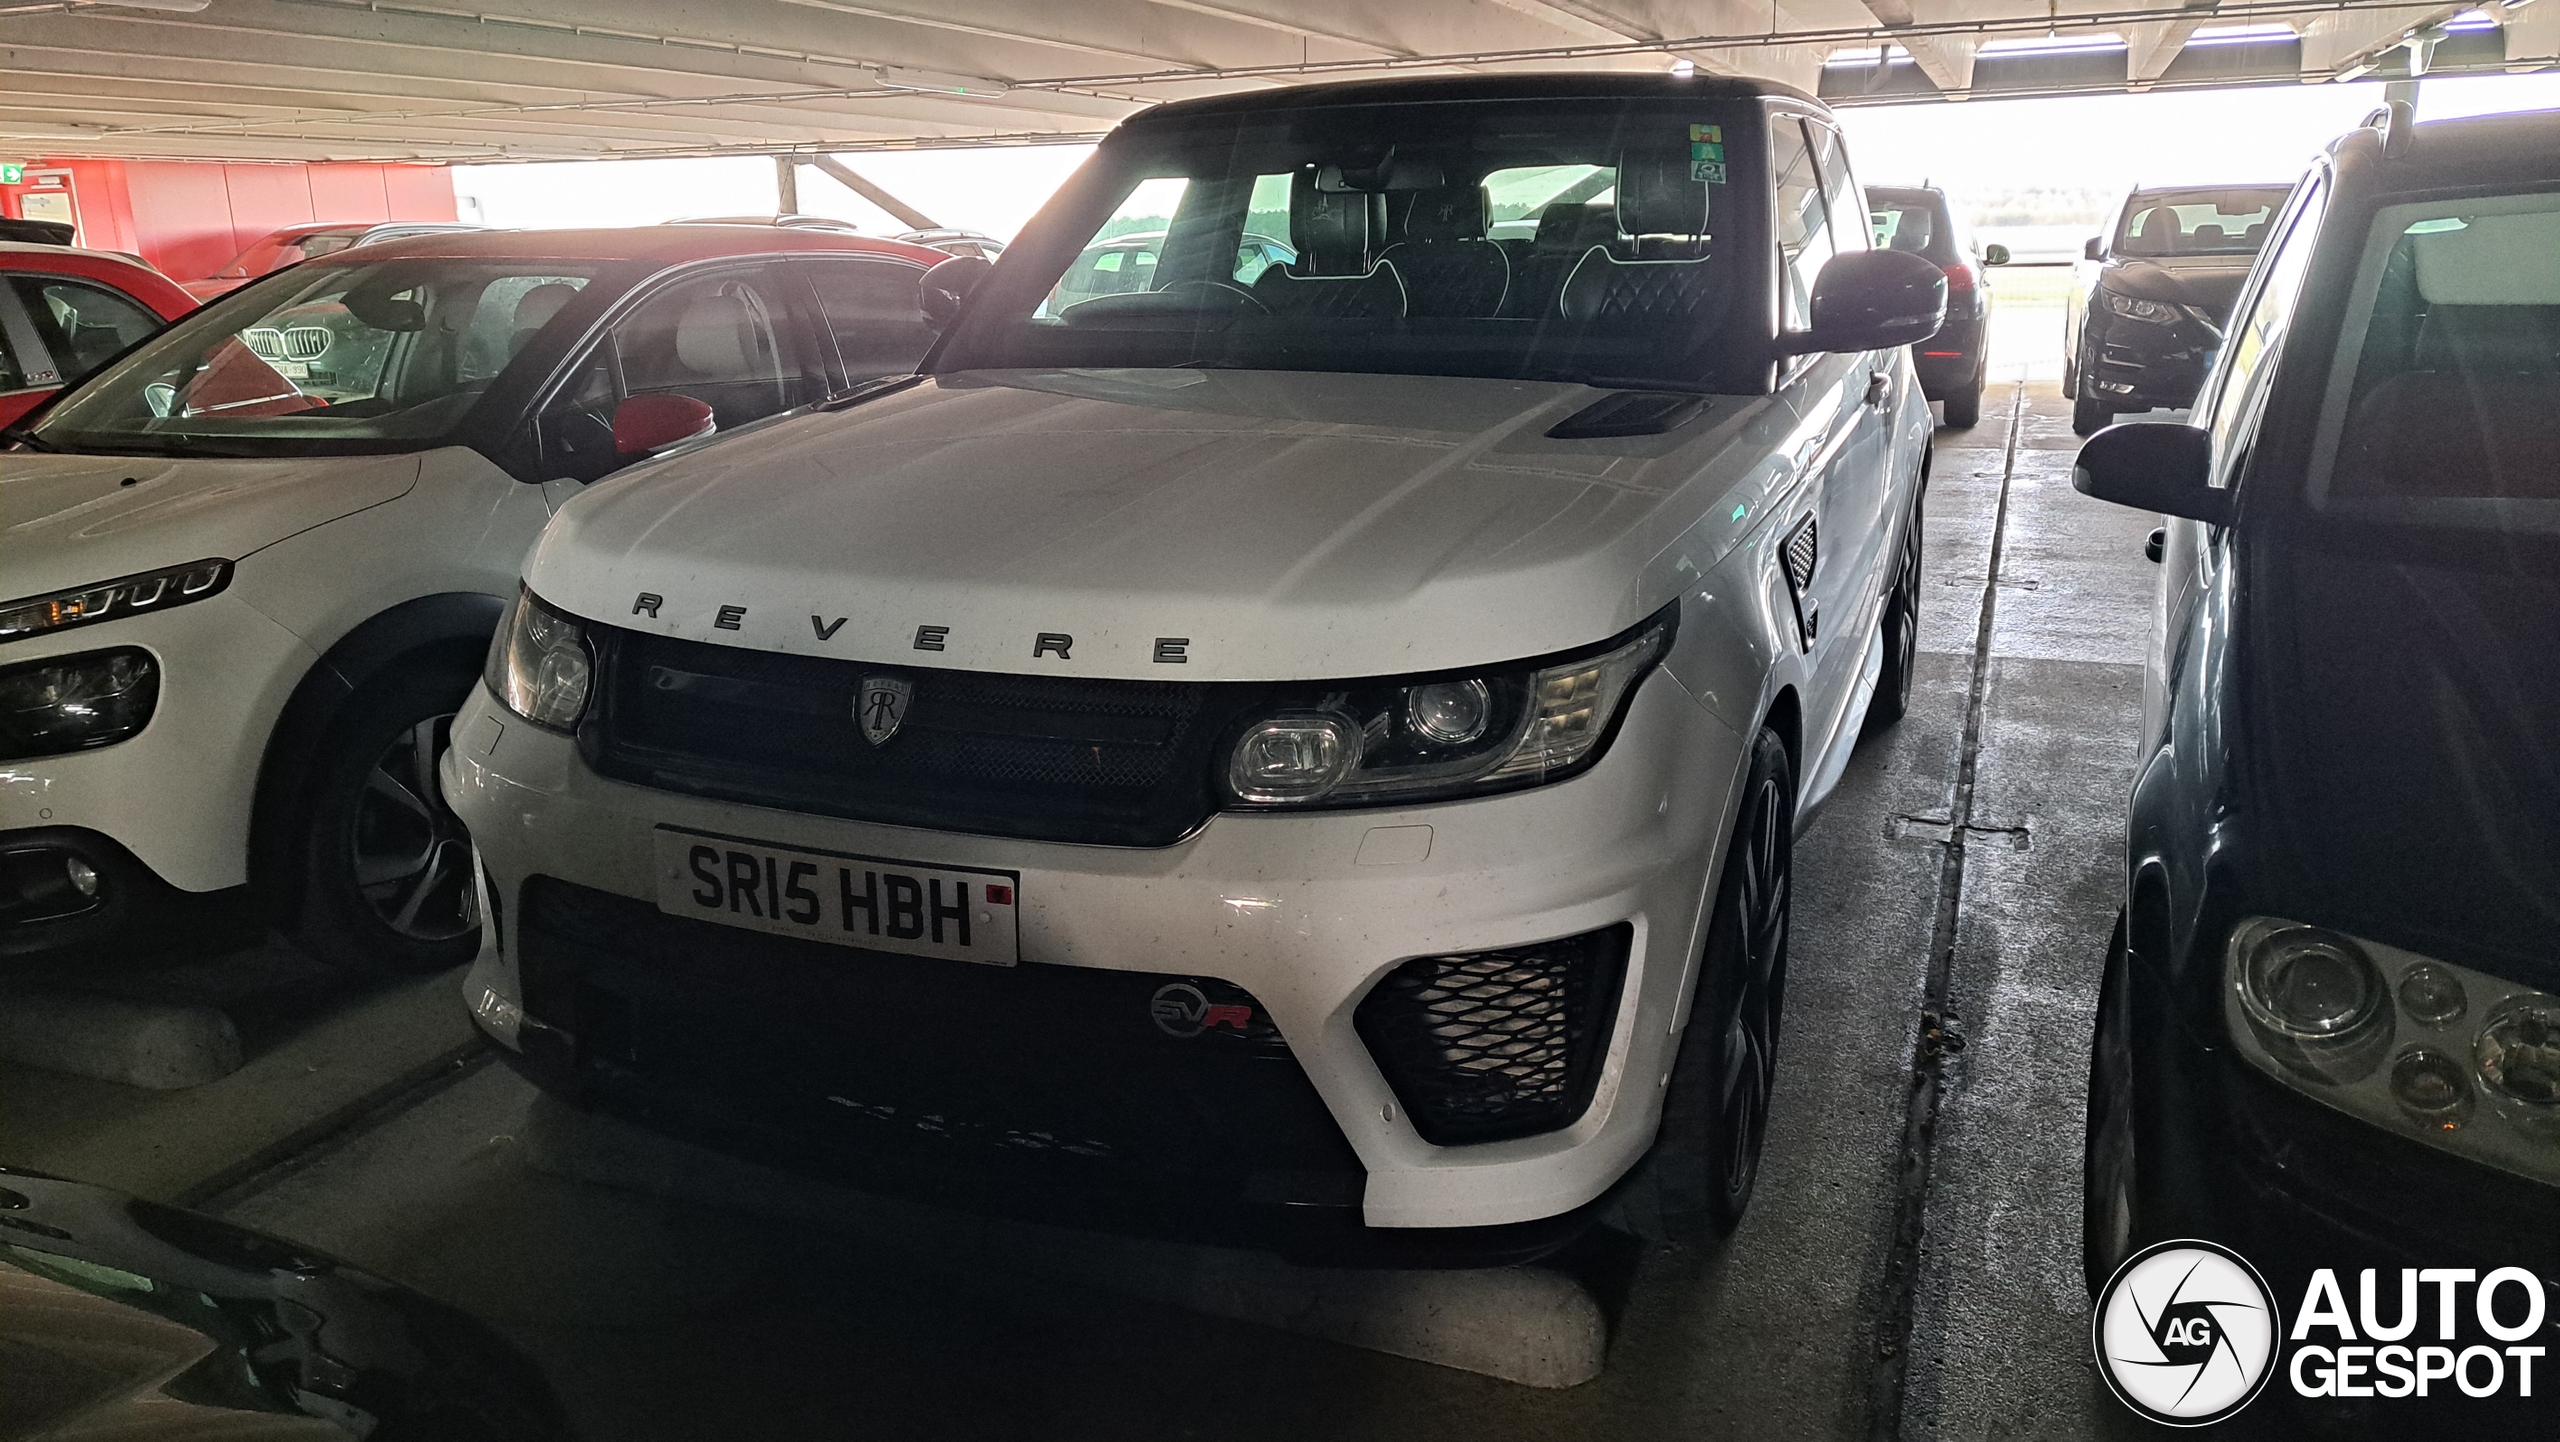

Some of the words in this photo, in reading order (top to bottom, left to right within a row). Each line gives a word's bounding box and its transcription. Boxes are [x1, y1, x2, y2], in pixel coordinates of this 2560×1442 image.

[631, 591, 1191, 664] REVERE
[689, 844, 821, 926] SR15
[839, 867, 971, 947] HBH
[1151, 997, 1252, 1030] SVR
